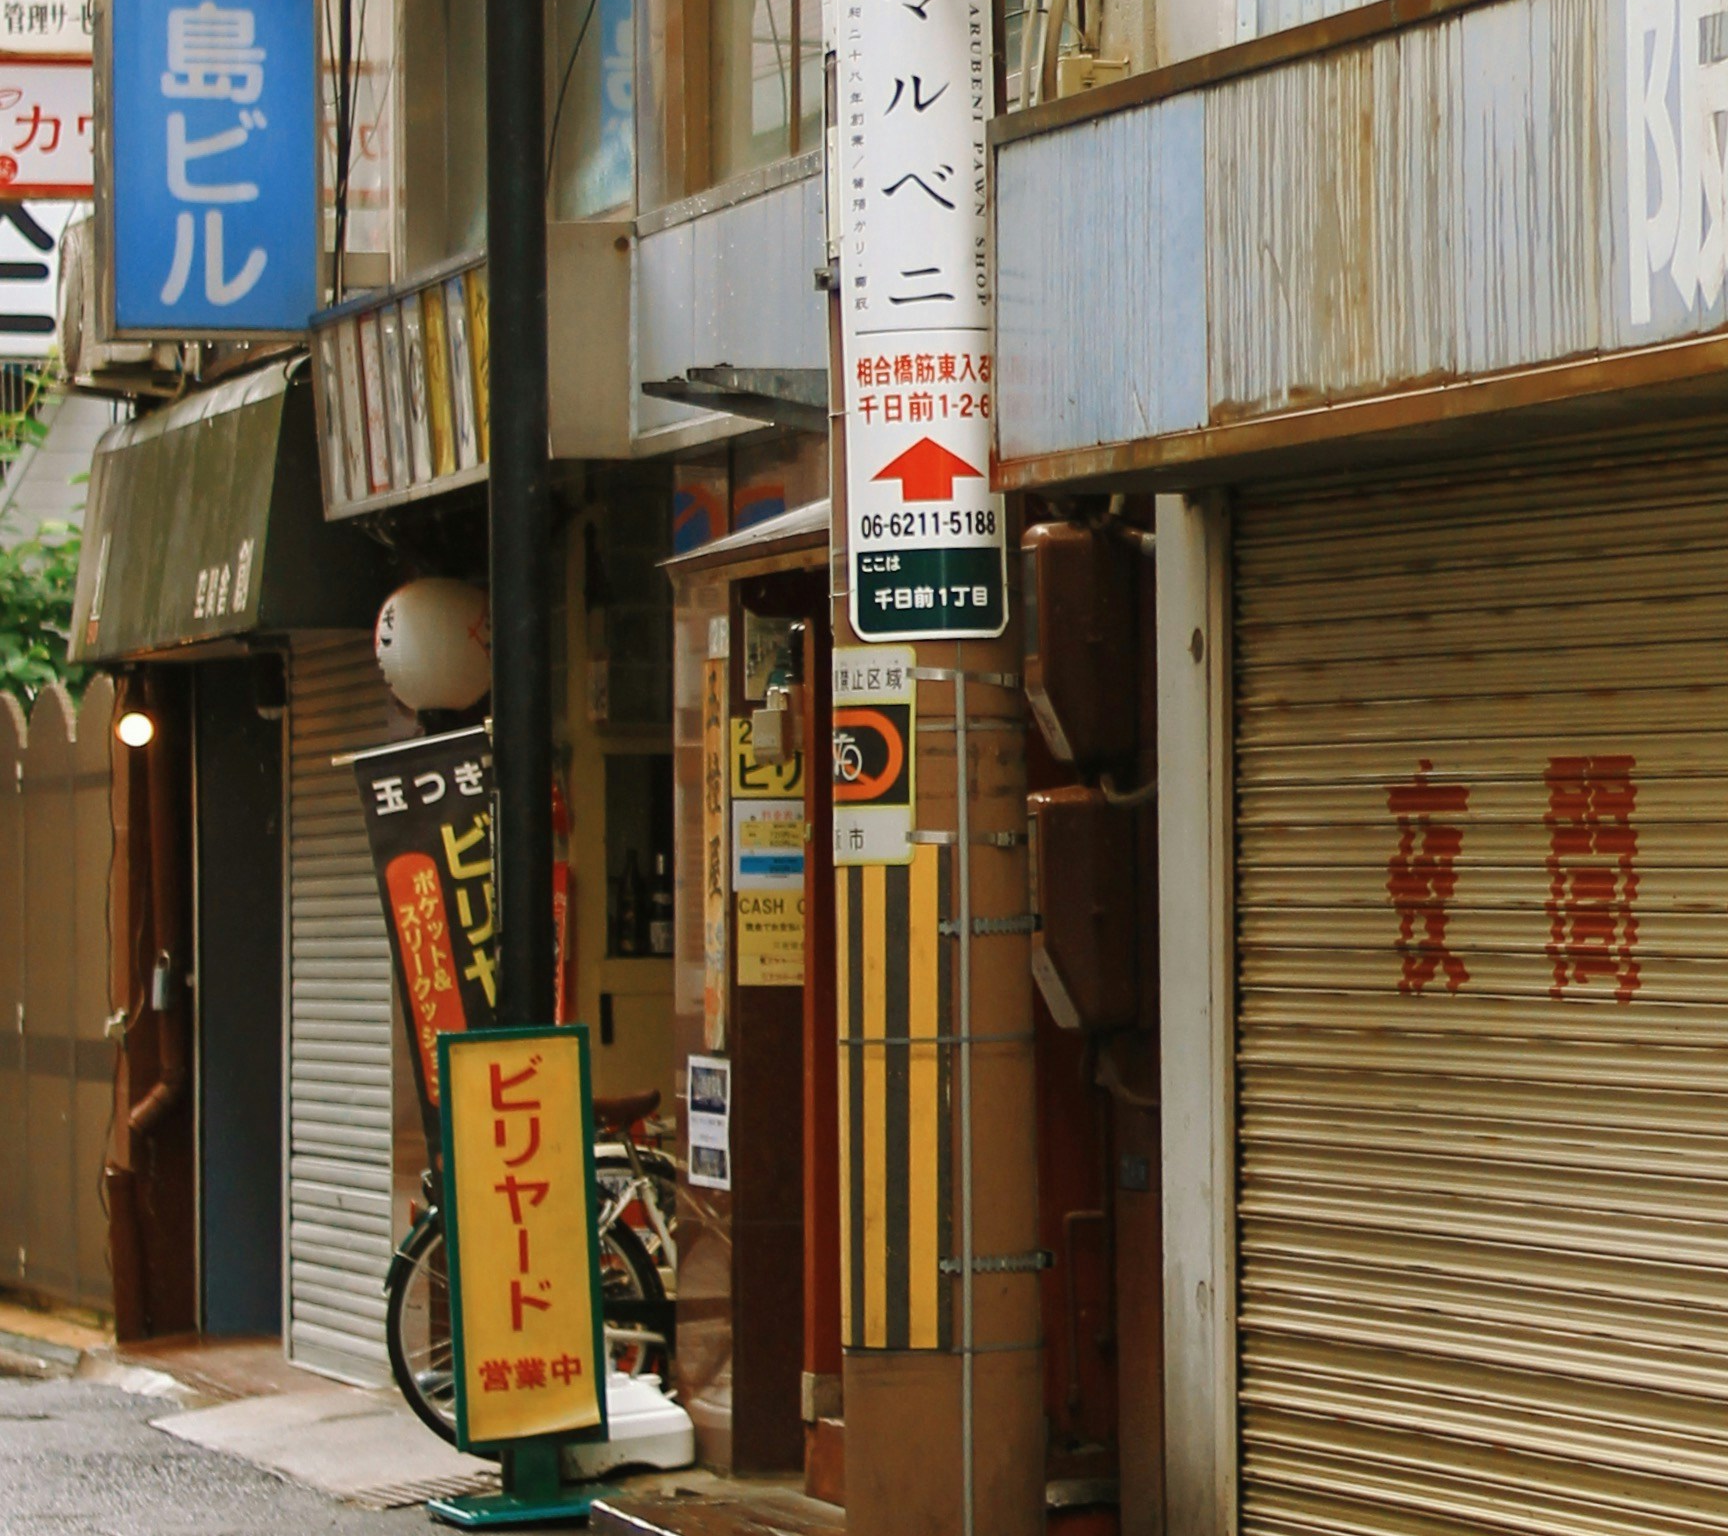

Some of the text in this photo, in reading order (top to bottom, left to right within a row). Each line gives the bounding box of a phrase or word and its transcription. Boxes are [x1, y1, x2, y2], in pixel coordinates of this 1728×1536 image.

[973, 141, 986, 217] PAWN
[975, 237, 988, 306] SHOP
[861, 511, 996, 539] 06-6211-5188
[861, 555, 901, 573] ここは
[874, 586, 988, 611] 千日前1丁目
[372, 761, 484, 817] 玉つき
[739, 898, 784, 914] CASH
[489, 1054, 552, 1332] ビリヤード
[479, 1353, 582, 1393] 営業中
